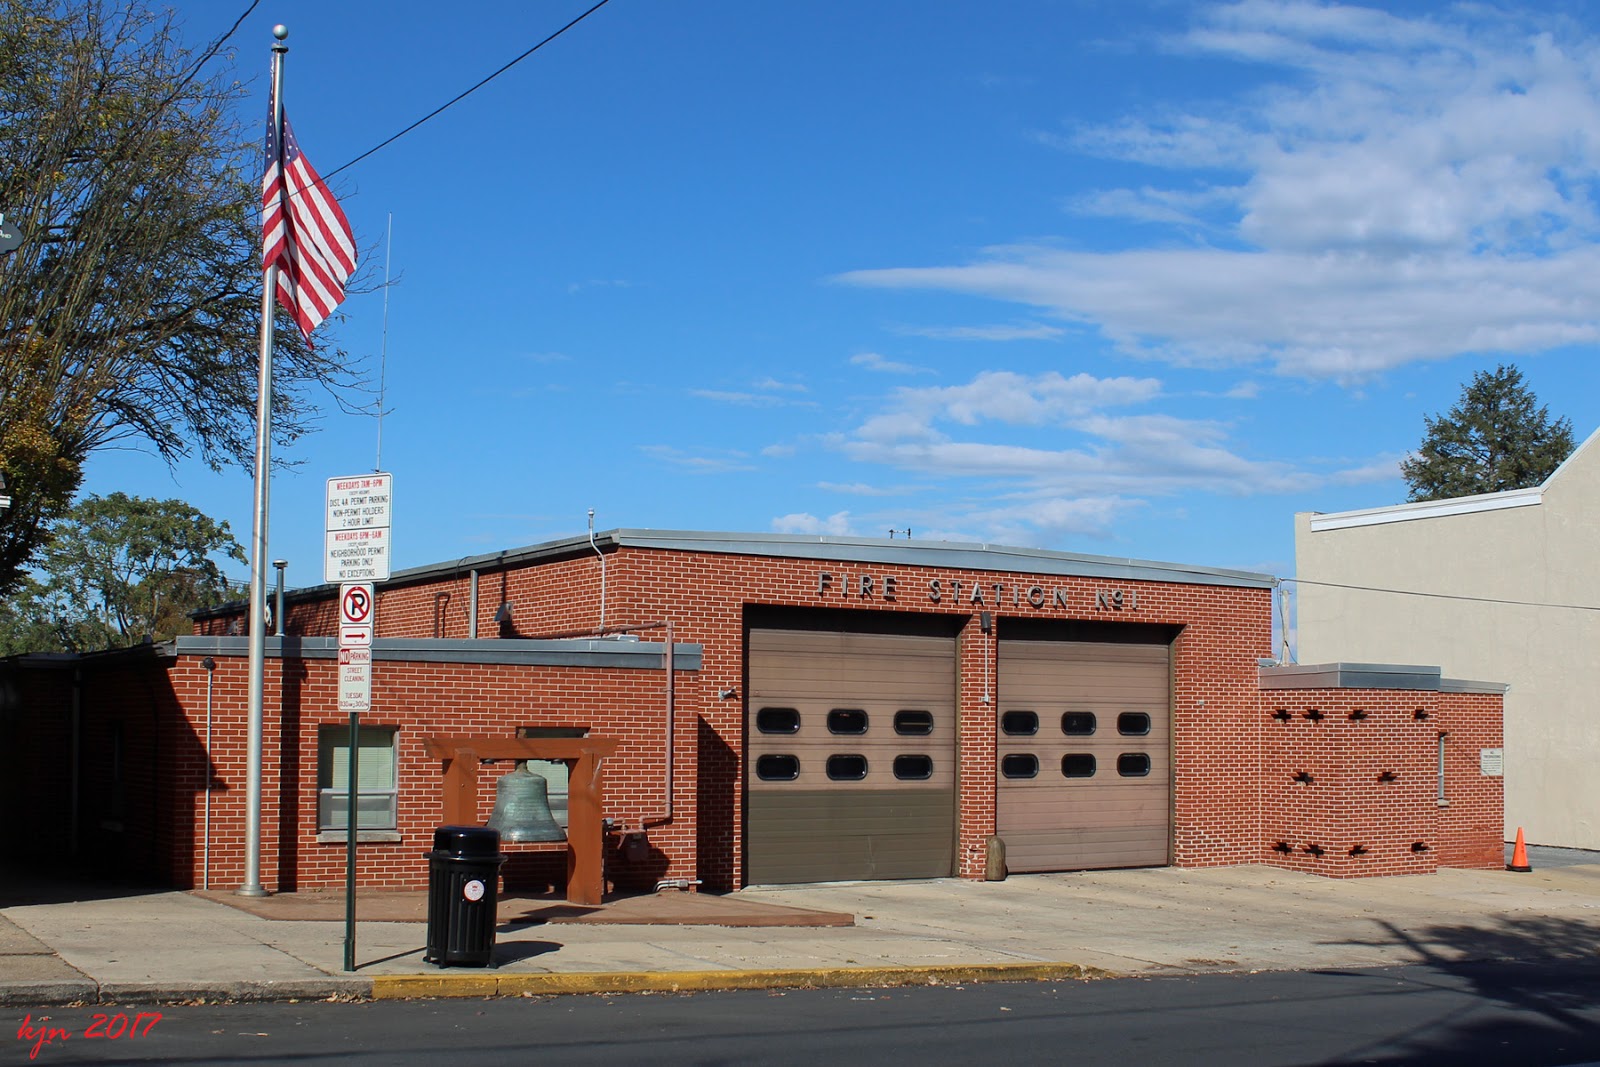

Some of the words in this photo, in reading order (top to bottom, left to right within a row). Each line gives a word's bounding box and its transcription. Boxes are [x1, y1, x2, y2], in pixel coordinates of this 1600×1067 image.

[351, 497, 367, 505] PERMIT
[369, 495, 388, 504] PARKING
[362, 507, 384, 515] HOLDERS
[348, 518, 360, 526] HOUR
[362, 517, 374, 525] LIMIT
[331, 548, 366, 557] NEIGHBORHOOD
[368, 547, 385, 555] PERMIT
[341, 558, 360, 567] PARKING
[362, 558, 373, 566] ONLY
[339, 570, 346, 578] NO
[348, 569, 375, 578] EXCEPTIONS
[818, 572, 897, 599] FIRE
[928, 579, 1067, 608] STATION
[340, 651, 349, 663] NO
[351, 652, 368, 660] PARKING
